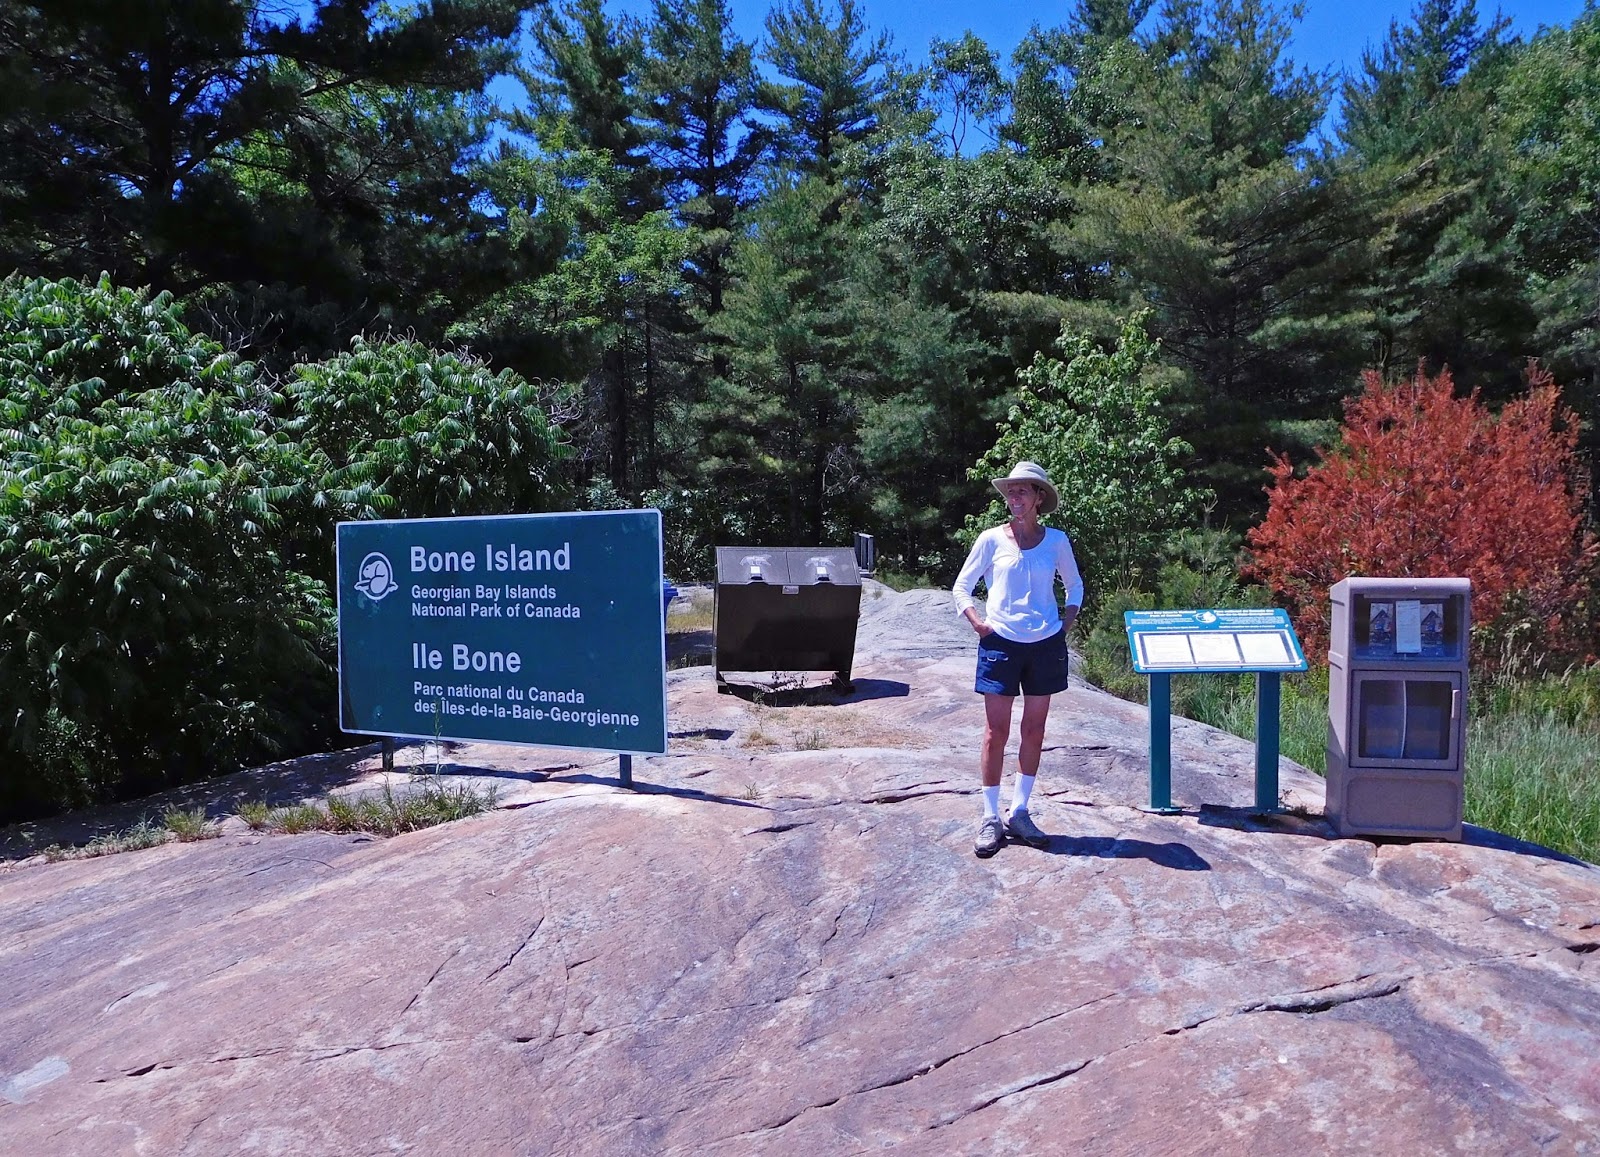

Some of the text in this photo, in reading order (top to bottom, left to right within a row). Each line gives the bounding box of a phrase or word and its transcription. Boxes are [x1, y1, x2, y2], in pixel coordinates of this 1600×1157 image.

[410, 543, 571, 572] Bone Island
[411, 584, 557, 602] Georgian Bay Islands
[412, 602, 581, 619] National Park of Canada
[412, 642, 521, 673] Ile Bone
[413, 681, 585, 704] Parc national du Canada
[414, 696, 640, 727] des Îles-de-la-Baie-Georgienne
